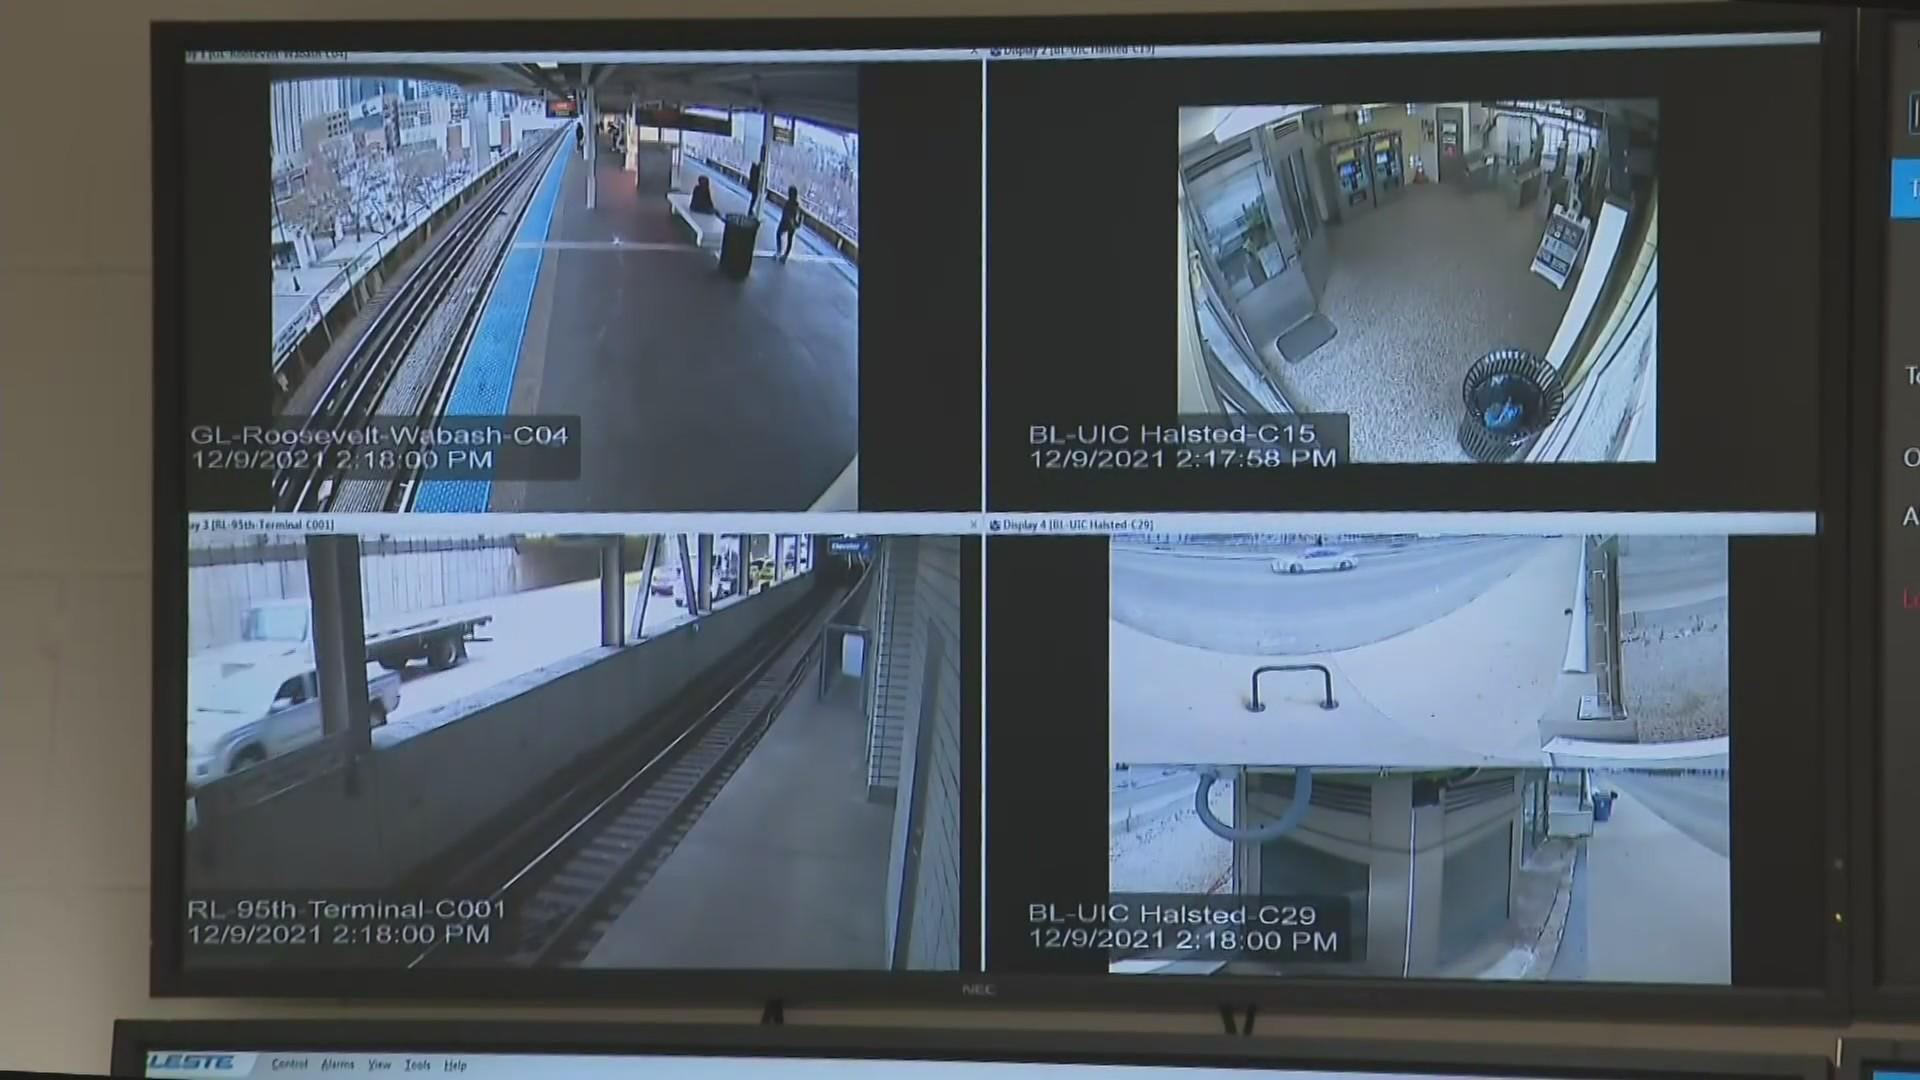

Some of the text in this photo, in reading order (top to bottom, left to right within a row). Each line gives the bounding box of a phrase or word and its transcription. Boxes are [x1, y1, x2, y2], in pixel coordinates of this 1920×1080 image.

[191, 426, 569, 447] GL-Roosevelt-Wabash-C04
[1029, 424, 1317, 444] BL-UIC Halsted-C15
[192, 449, 493, 470] 12/9/2021 2:18:00 PM
[1031, 449, 1337, 468] 12/9/2021 2:17:58 PM
[1003, 519, 1038, 533] Display
[1040, 519, 1047, 529] 4
[187, 899, 505, 919] RL-95th-Terminal-C001
[1029, 903, 1317, 925] BL-UIC Halsted-C29
[188, 924, 490, 944] 12/9/2021 2:18:00 PM
[1030, 928, 1338, 951] 12/9/2021 2:18:00 PM
[962, 983, 996, 995] NEC
[272, 1058, 468, 1073] Control Alarms View Tools Help
